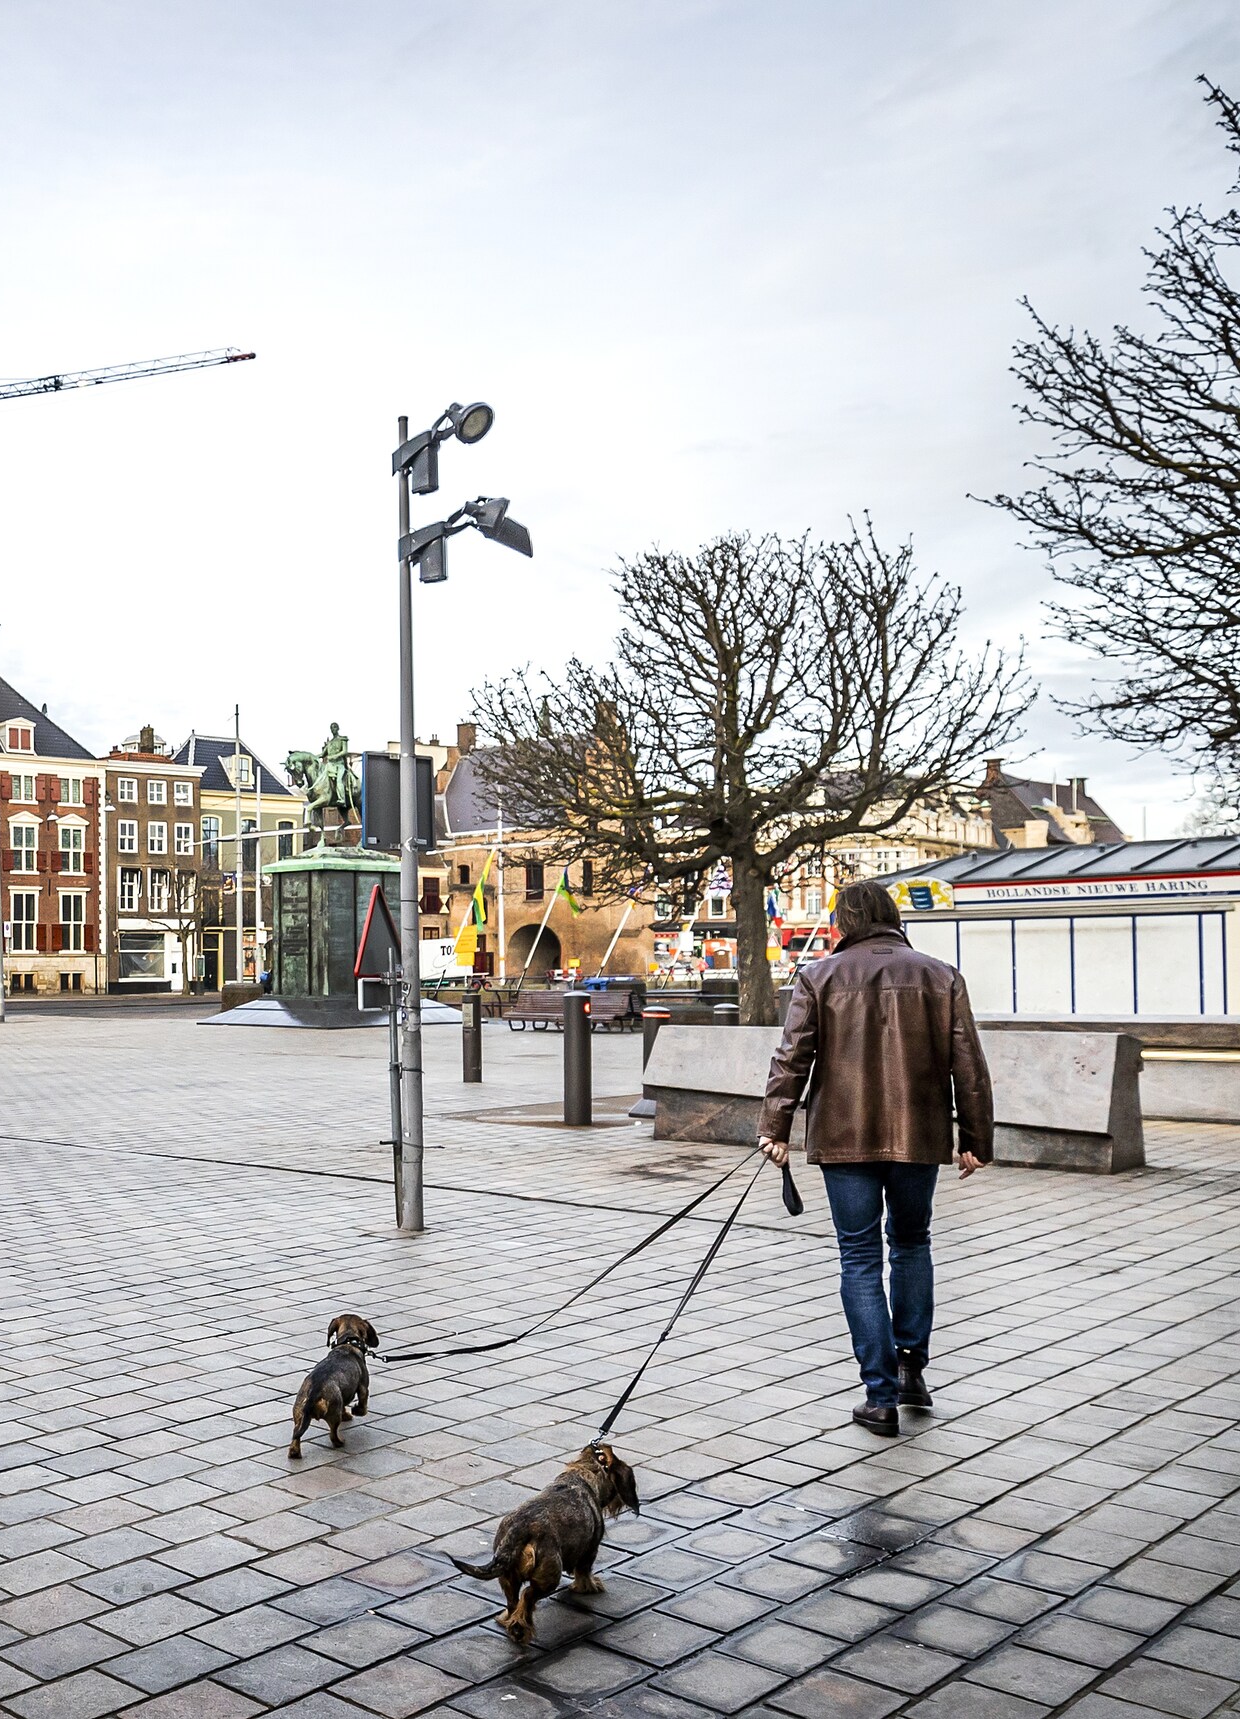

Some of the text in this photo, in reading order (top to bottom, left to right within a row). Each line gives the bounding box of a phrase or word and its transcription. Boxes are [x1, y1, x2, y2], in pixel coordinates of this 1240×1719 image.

[986, 880, 1208, 898] HOLLANDSE NIEUWE HARING
